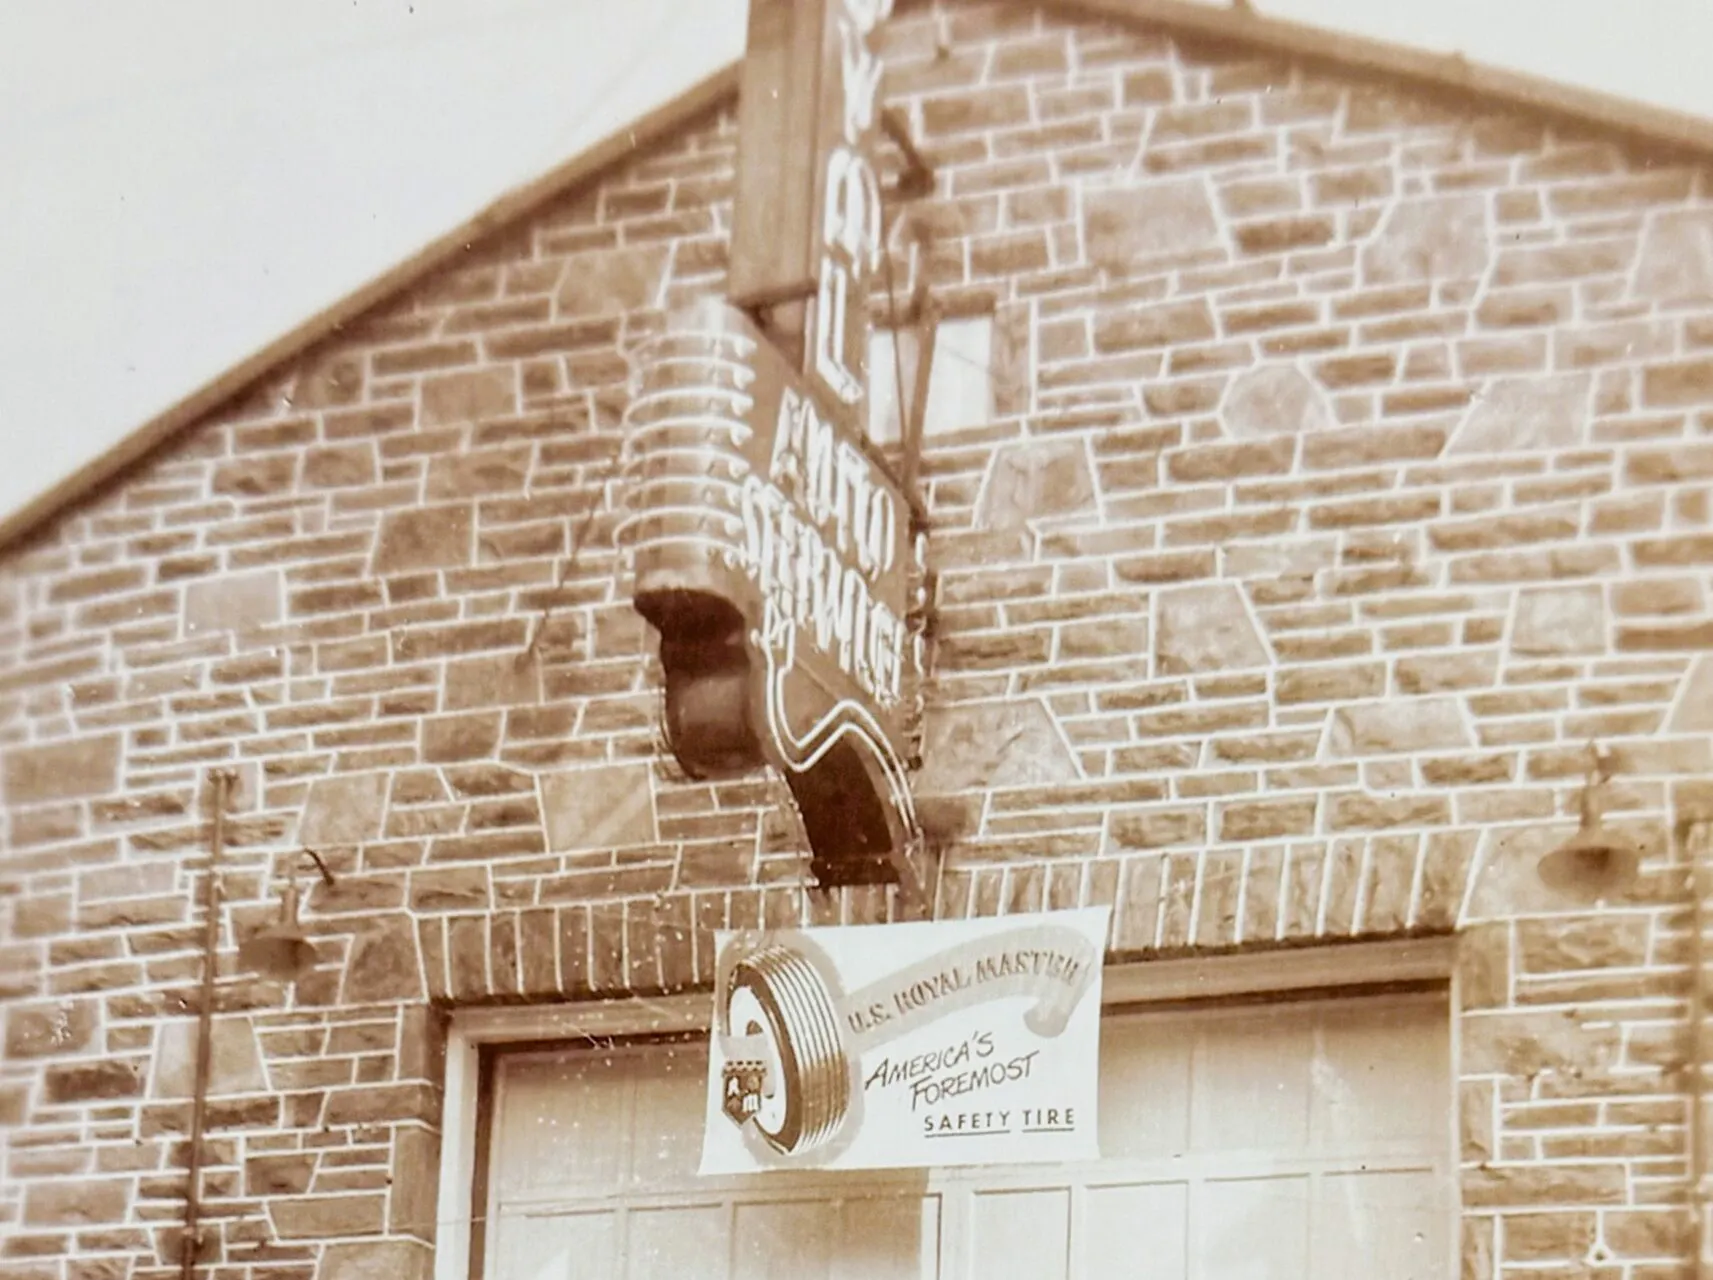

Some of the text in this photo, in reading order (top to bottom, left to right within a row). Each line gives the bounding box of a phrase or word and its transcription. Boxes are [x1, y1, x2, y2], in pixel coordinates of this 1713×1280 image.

[769, 386, 896, 583] AUTO
[847, 950, 1079, 1034] U.S. ROYAL MASTER
[864, 1031, 995, 1091] AMERICA'S
[909, 1050, 1040, 1112] FOREMOST
[924, 1108, 1075, 1132] SAFETY TIRE
